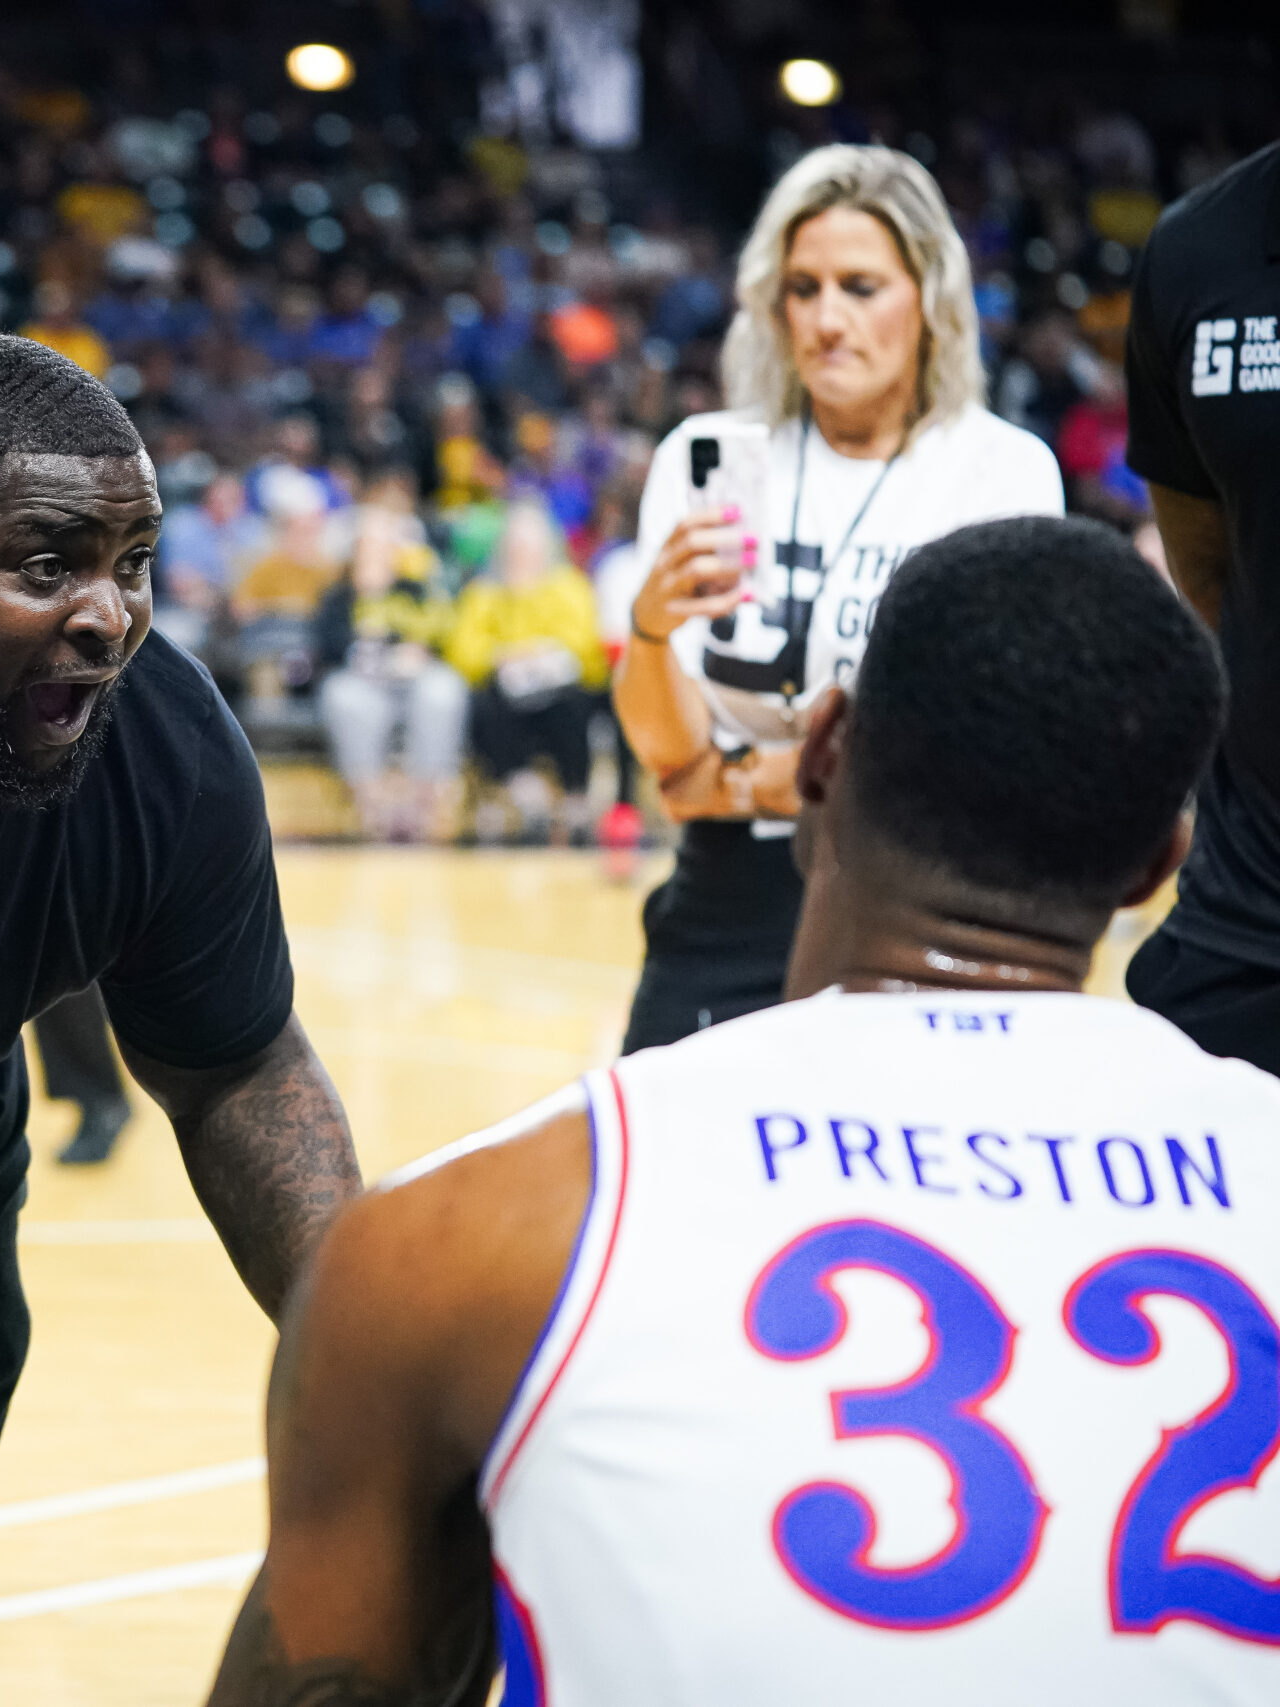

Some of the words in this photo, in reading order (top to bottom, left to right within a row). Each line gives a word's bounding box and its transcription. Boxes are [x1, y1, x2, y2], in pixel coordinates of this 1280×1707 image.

[1243, 316, 1279, 341] THE
[1239, 365, 1280, 393] GAM
[853, 543, 908, 580] TH
[753, 1112, 1234, 1210] PRESTON
[743, 1217, 1280, 1647] 32
